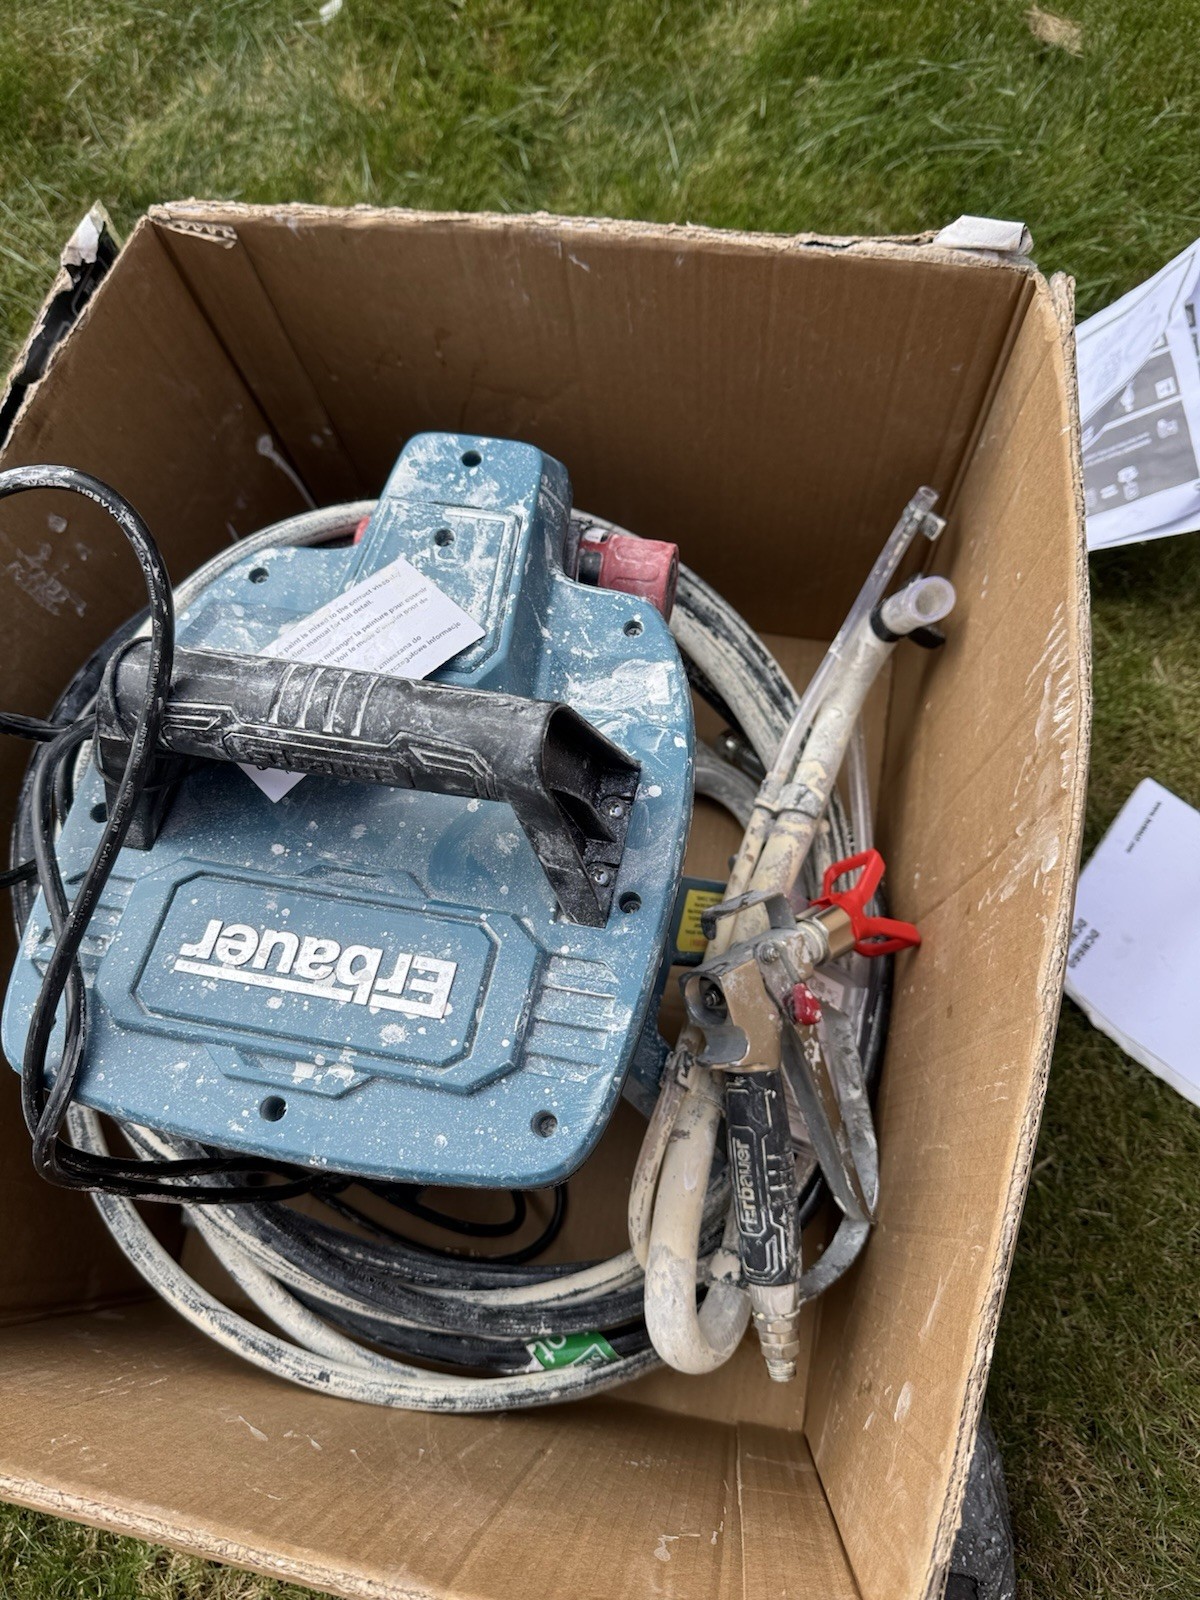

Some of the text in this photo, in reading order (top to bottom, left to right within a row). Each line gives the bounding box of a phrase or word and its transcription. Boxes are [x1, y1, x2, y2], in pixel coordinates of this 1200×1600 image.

[282, 637, 302, 653] paint
[300, 631, 308, 639] is
[307, 617, 329, 634] mixed
[336, 603, 348, 614] the
[348, 588, 372, 606] correct
[304, 627, 331, 648] manual
[340, 612, 353, 622] full
[353, 629, 361, 637] la
[360, 610, 389, 632] peinture
[388, 601, 404, 614] pour
[426, 620, 461, 646] informacje
[333, 651, 349, 664] Voir
[348, 645, 357, 653] le
[411, 634, 422, 644] do
[173, 919, 457, 1019] Erbauer
[730, 1134, 759, 1225] Erbauer
